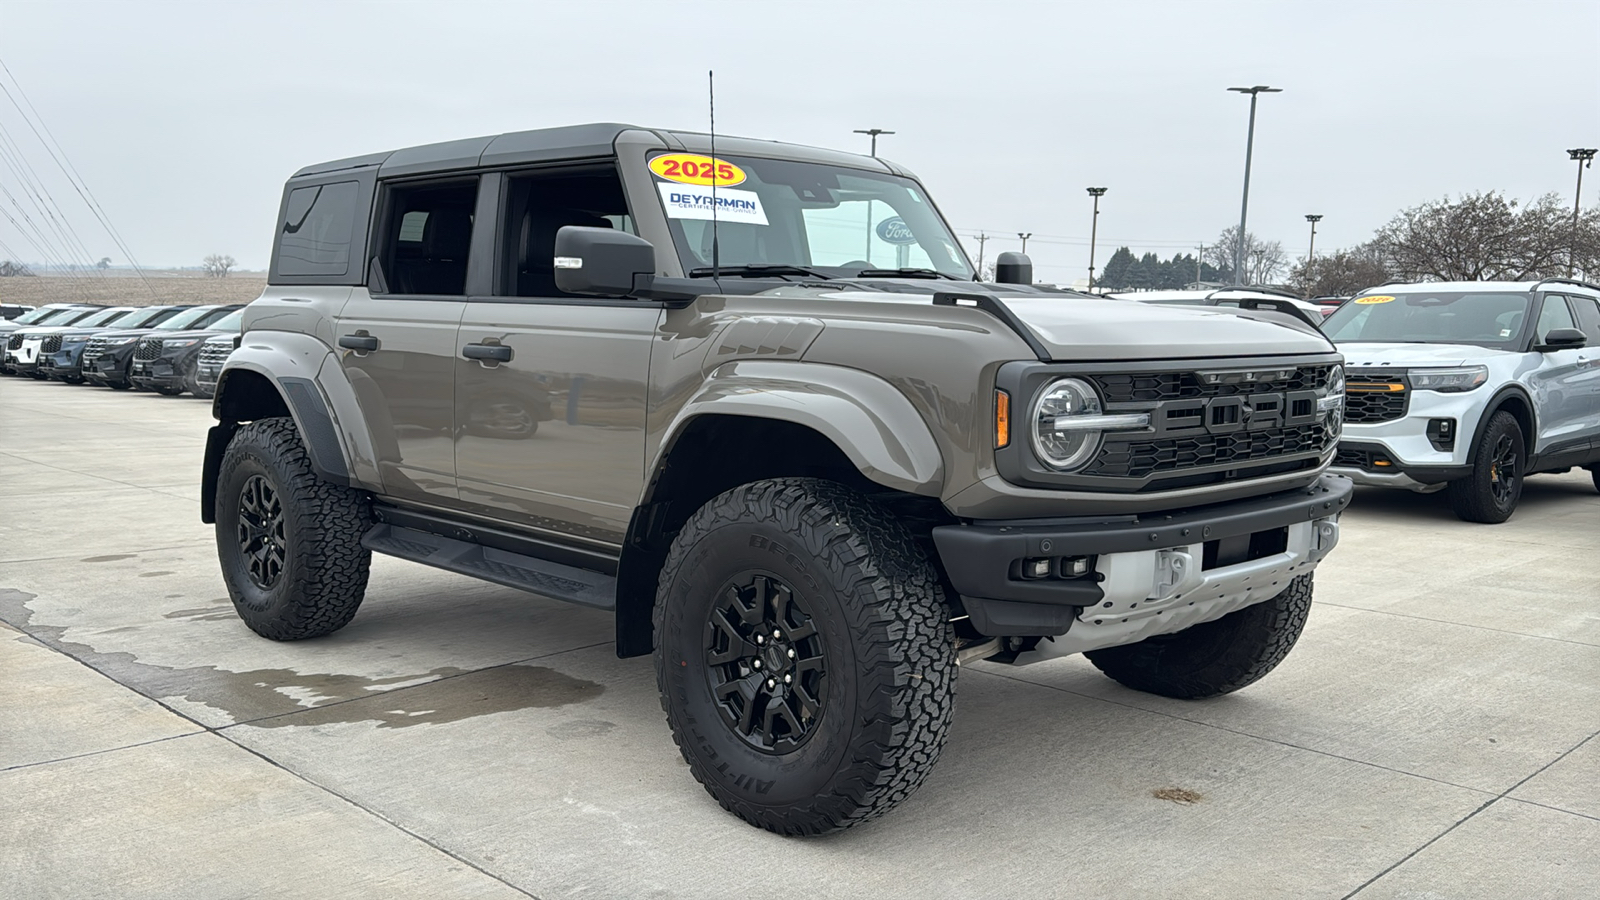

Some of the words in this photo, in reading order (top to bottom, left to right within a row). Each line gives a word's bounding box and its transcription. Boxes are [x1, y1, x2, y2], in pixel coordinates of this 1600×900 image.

[662, 159, 735, 181] 2025
[670, 193, 756, 210] DEYARMAN
[678, 203, 715, 211] CERTIFIED
[1156, 390, 1318, 439] FORD
